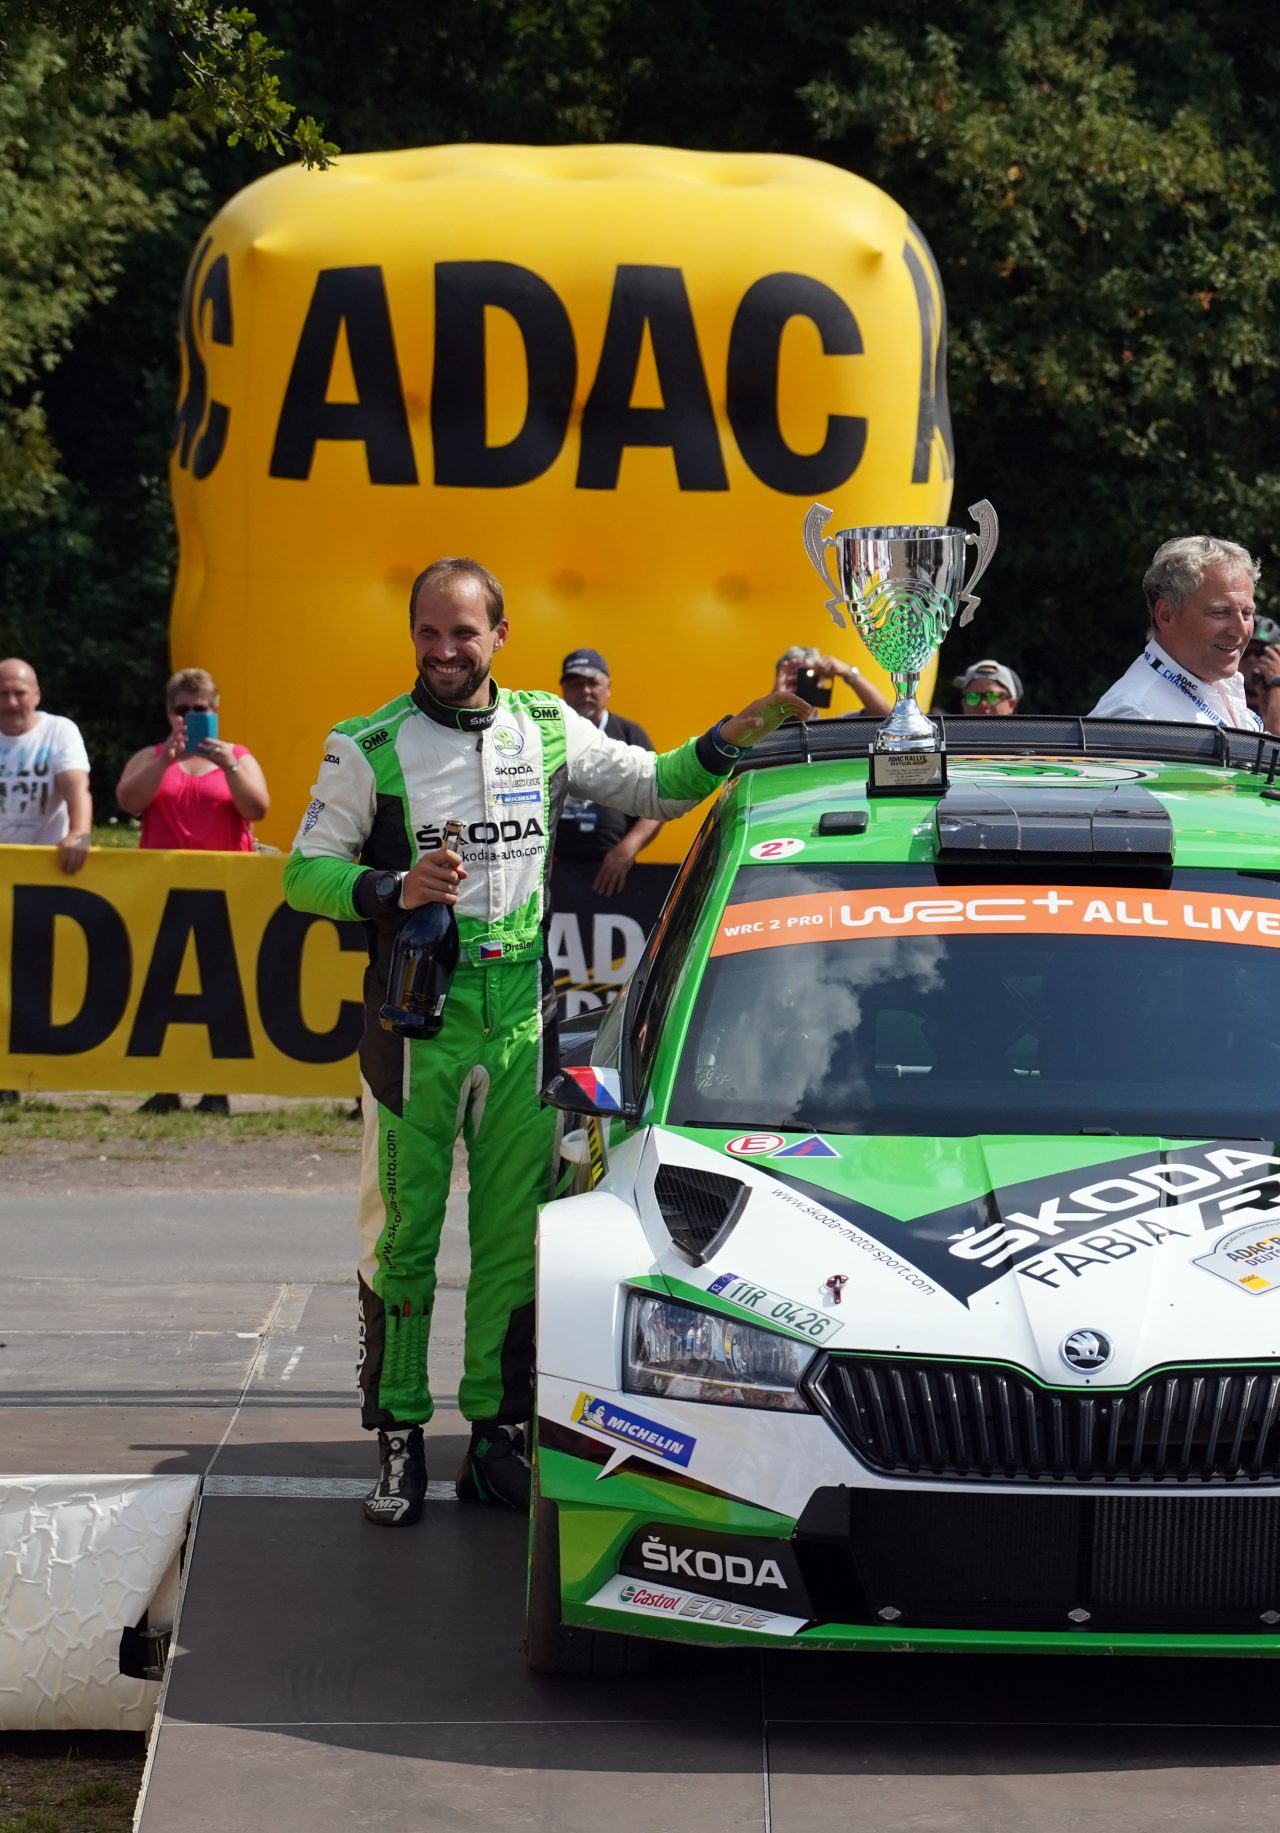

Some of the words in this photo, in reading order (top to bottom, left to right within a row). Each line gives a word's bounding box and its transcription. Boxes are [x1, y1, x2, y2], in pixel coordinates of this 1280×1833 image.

[269, 260, 868, 496] ADAC
[531, 708, 561, 719] OMP
[362, 731, 389, 750] OMP
[495, 766, 533, 776] ŠKODA
[416, 818, 544, 851] ŠODA
[724, 920, 764, 937] WRC
[770, 919, 781, 930] 2
[788, 914, 824, 928] PRO
[1083, 900, 1169, 926] ALL
[505, 940, 535, 953] Dresler
[740, 1136, 767, 1150] E
[771, 1188, 937, 1296] www.skoda-motorsport.com
[1016, 1218, 1191, 1288] FABIA
[1225, 1241, 1273, 1263] ADAC
[711, 1283, 722, 1293] CZ
[730, 1282, 767, 1307] 11R
[771, 1302, 831, 1336] 0426
[606, 1416, 684, 1455] MICHELIN
[641, 1535, 788, 1589] ŠKODA
[632, 1587, 682, 1610] Castrol
[679, 1596, 778, 1629] EDGE
